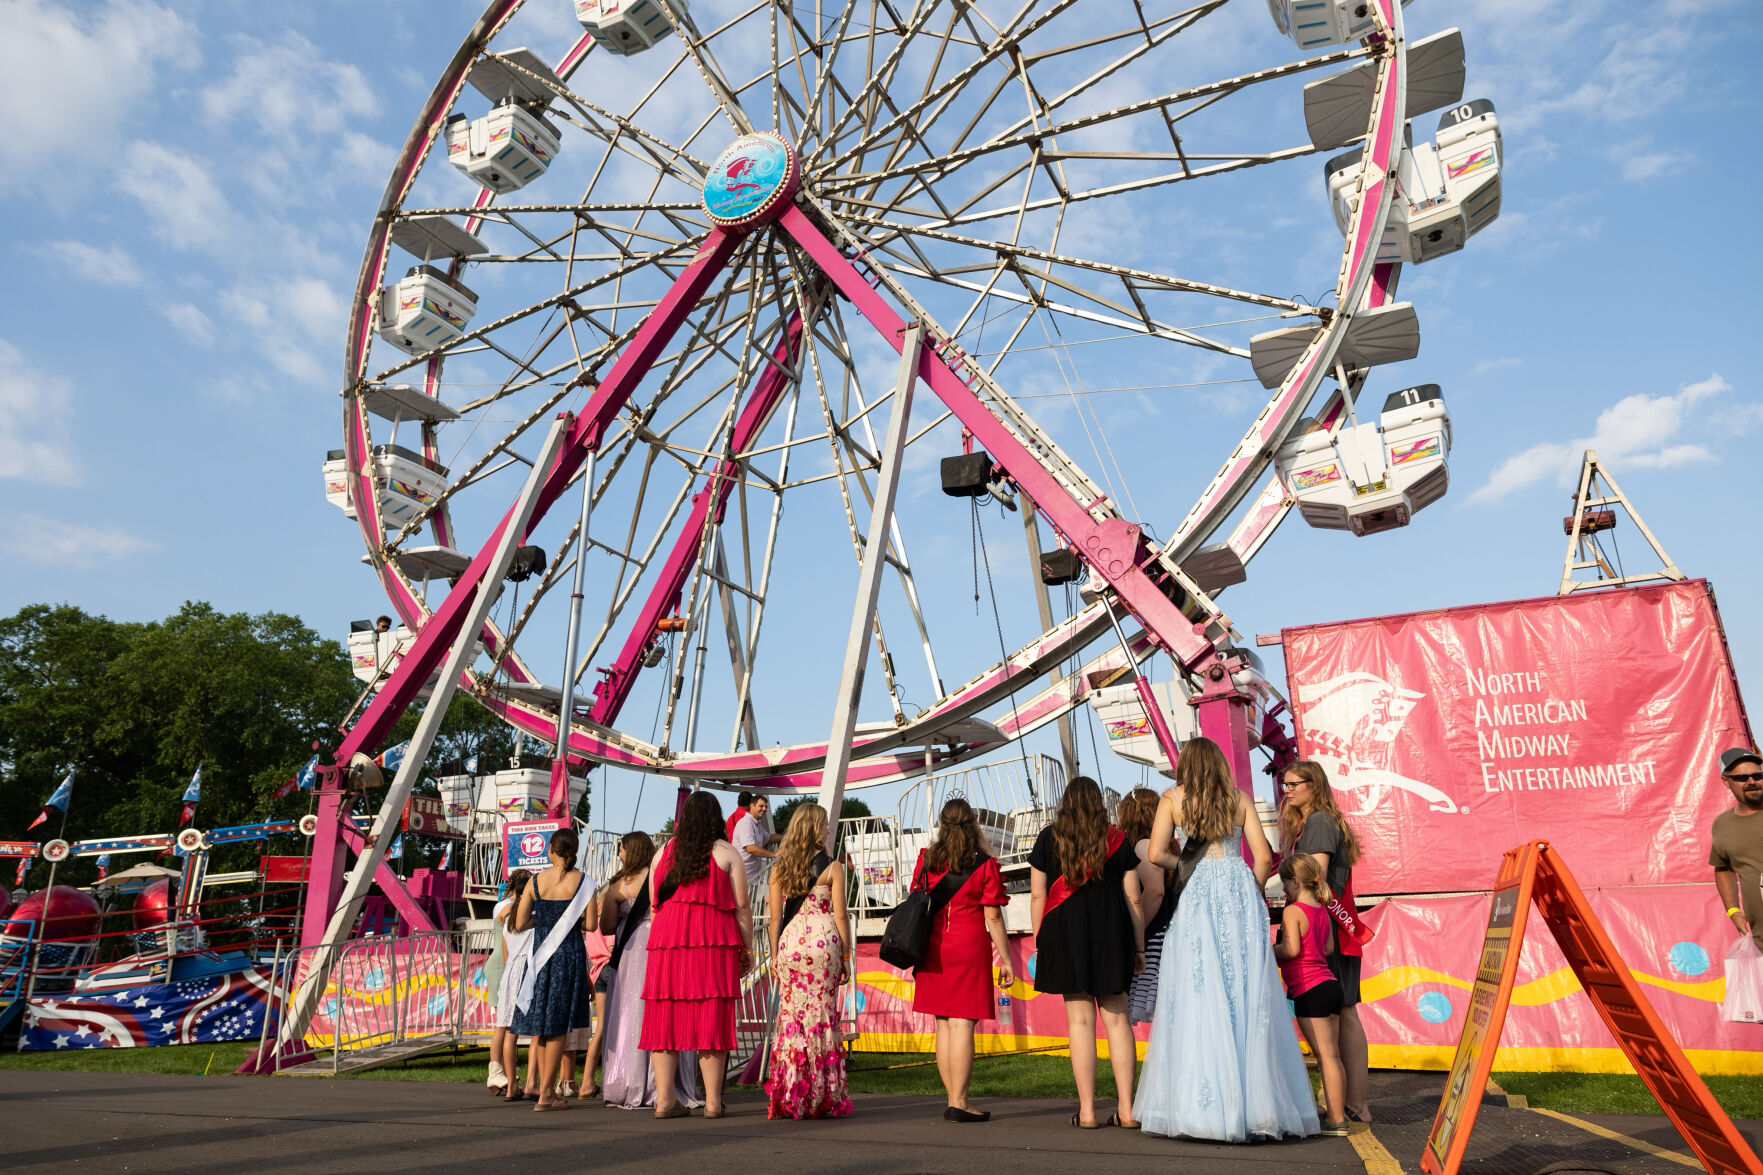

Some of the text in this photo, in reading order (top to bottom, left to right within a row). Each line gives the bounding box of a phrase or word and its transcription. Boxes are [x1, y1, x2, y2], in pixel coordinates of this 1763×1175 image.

[500, 97, 506, 107] 4
[1450, 104, 1473, 123] 10
[414, 266, 420, 276] 3
[1400, 388, 1421, 405] 11
[380, 445, 386, 455] 2
[1466, 668, 1541, 696] NORTH
[1475, 698, 1588, 728] AMERICAN
[1477, 729, 1570, 760] MIDWAY
[509, 756, 520, 769] 15
[1481, 761, 1657, 793] ENTERTAINMENT
[523, 836, 544, 853] 12
[518, 857, 548, 865] TICKETS
[1327, 899, 1353, 926] ONOR
